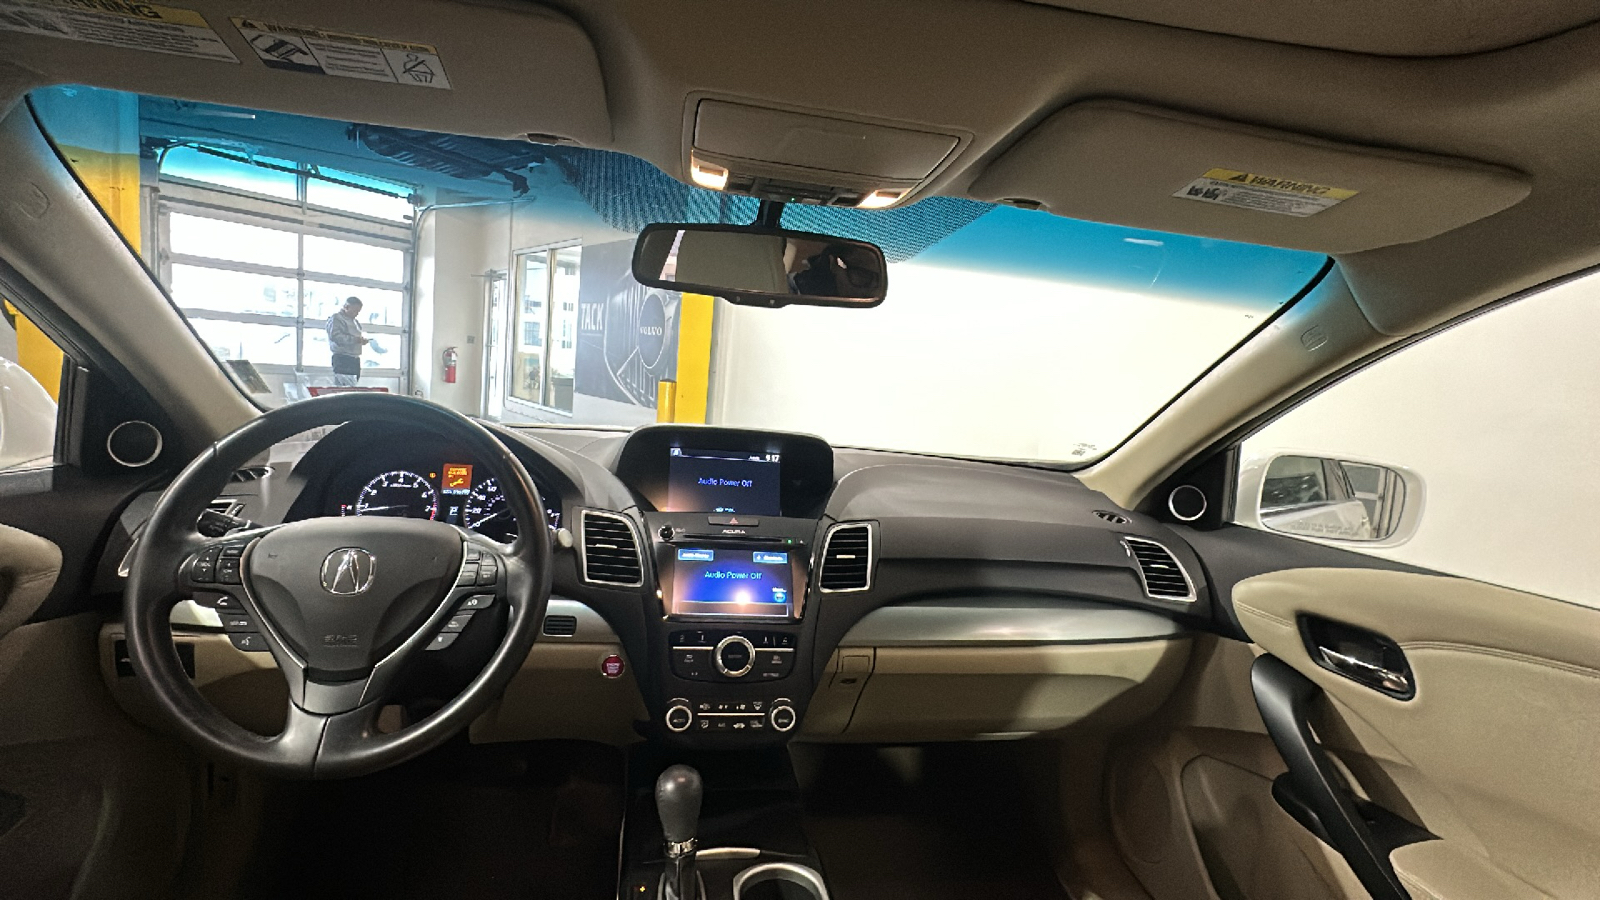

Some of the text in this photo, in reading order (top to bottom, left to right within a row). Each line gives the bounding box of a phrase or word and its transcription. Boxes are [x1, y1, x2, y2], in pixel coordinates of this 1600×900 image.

[1250, 175, 1330, 195] WARNING
[581, 302, 604, 331] TACK
[640, 326, 662, 336] VOLVO
[698, 478, 753, 488] Audio Power Off
[704, 571, 763, 580] Audio Power Off
